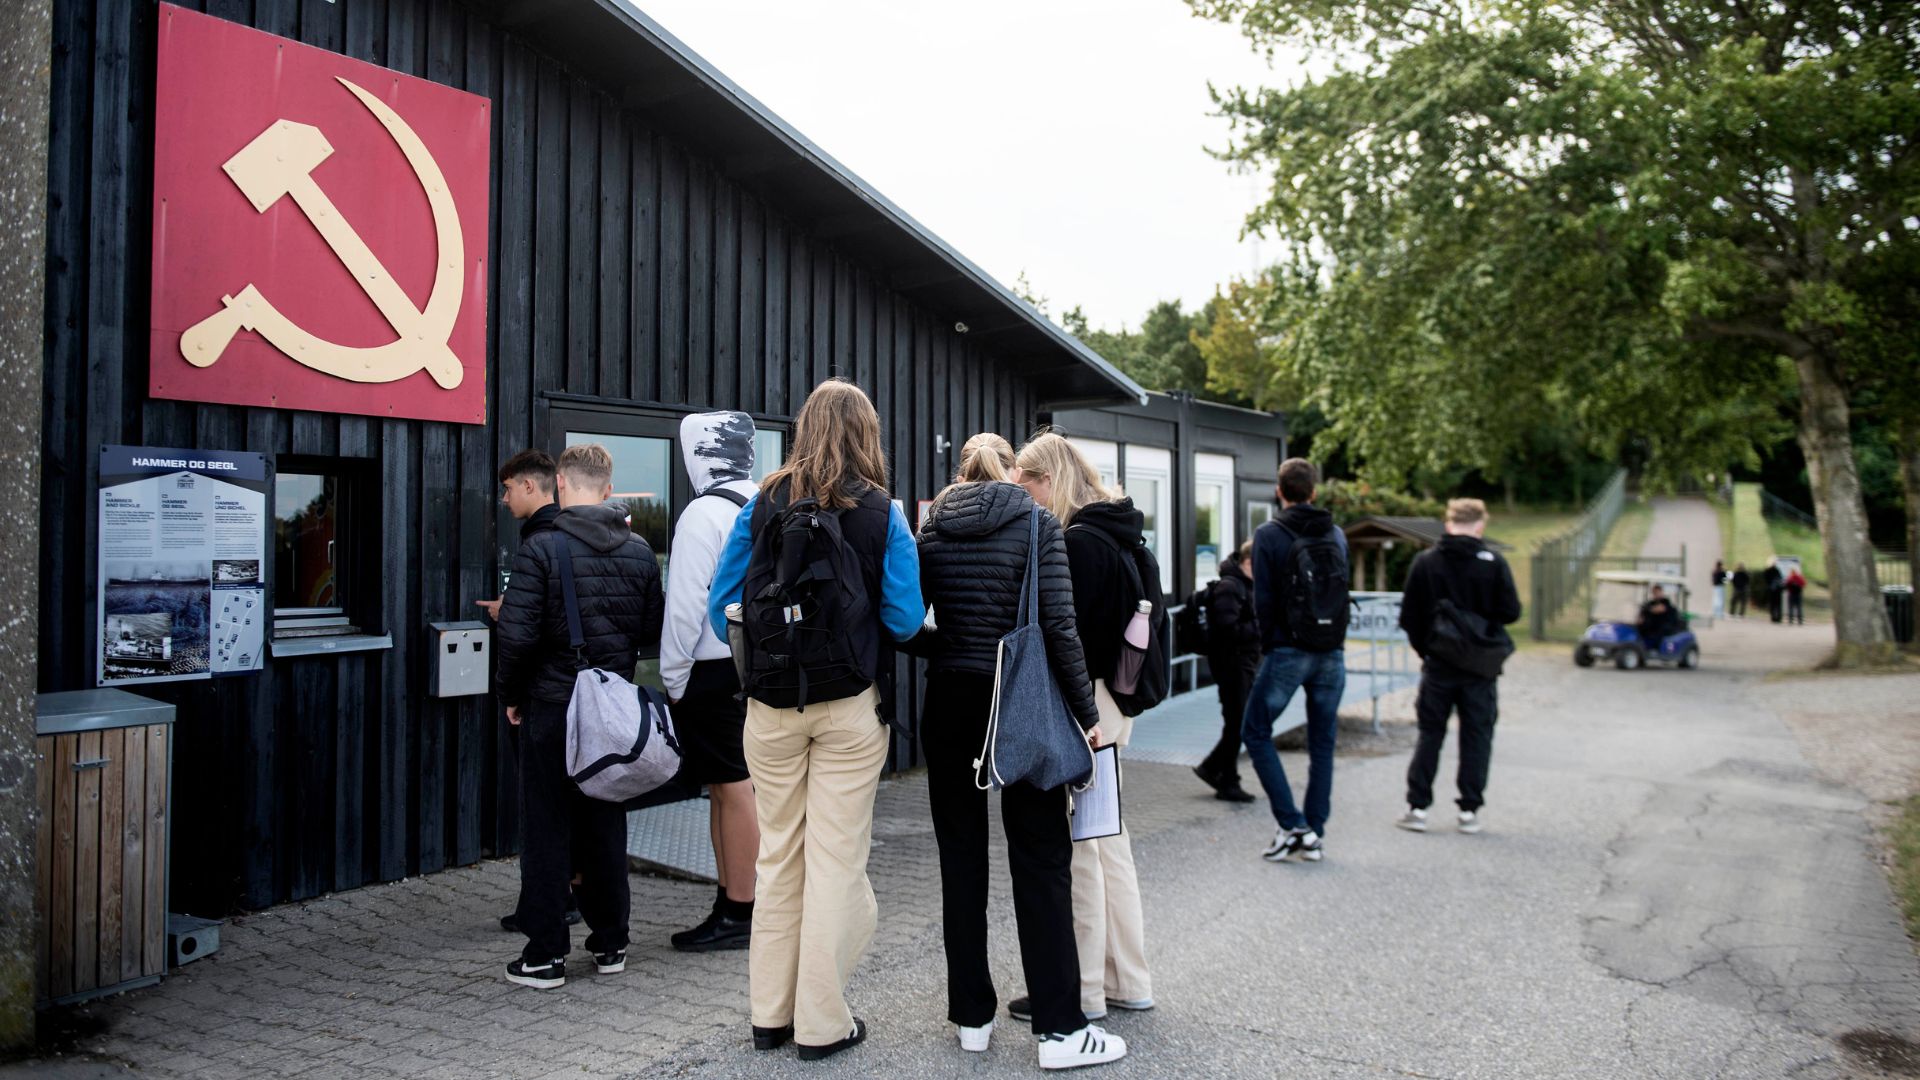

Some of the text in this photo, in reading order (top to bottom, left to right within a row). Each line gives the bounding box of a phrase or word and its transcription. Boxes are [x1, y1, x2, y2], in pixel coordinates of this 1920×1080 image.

[132, 457, 238, 471] HAMMER OG SEGL
